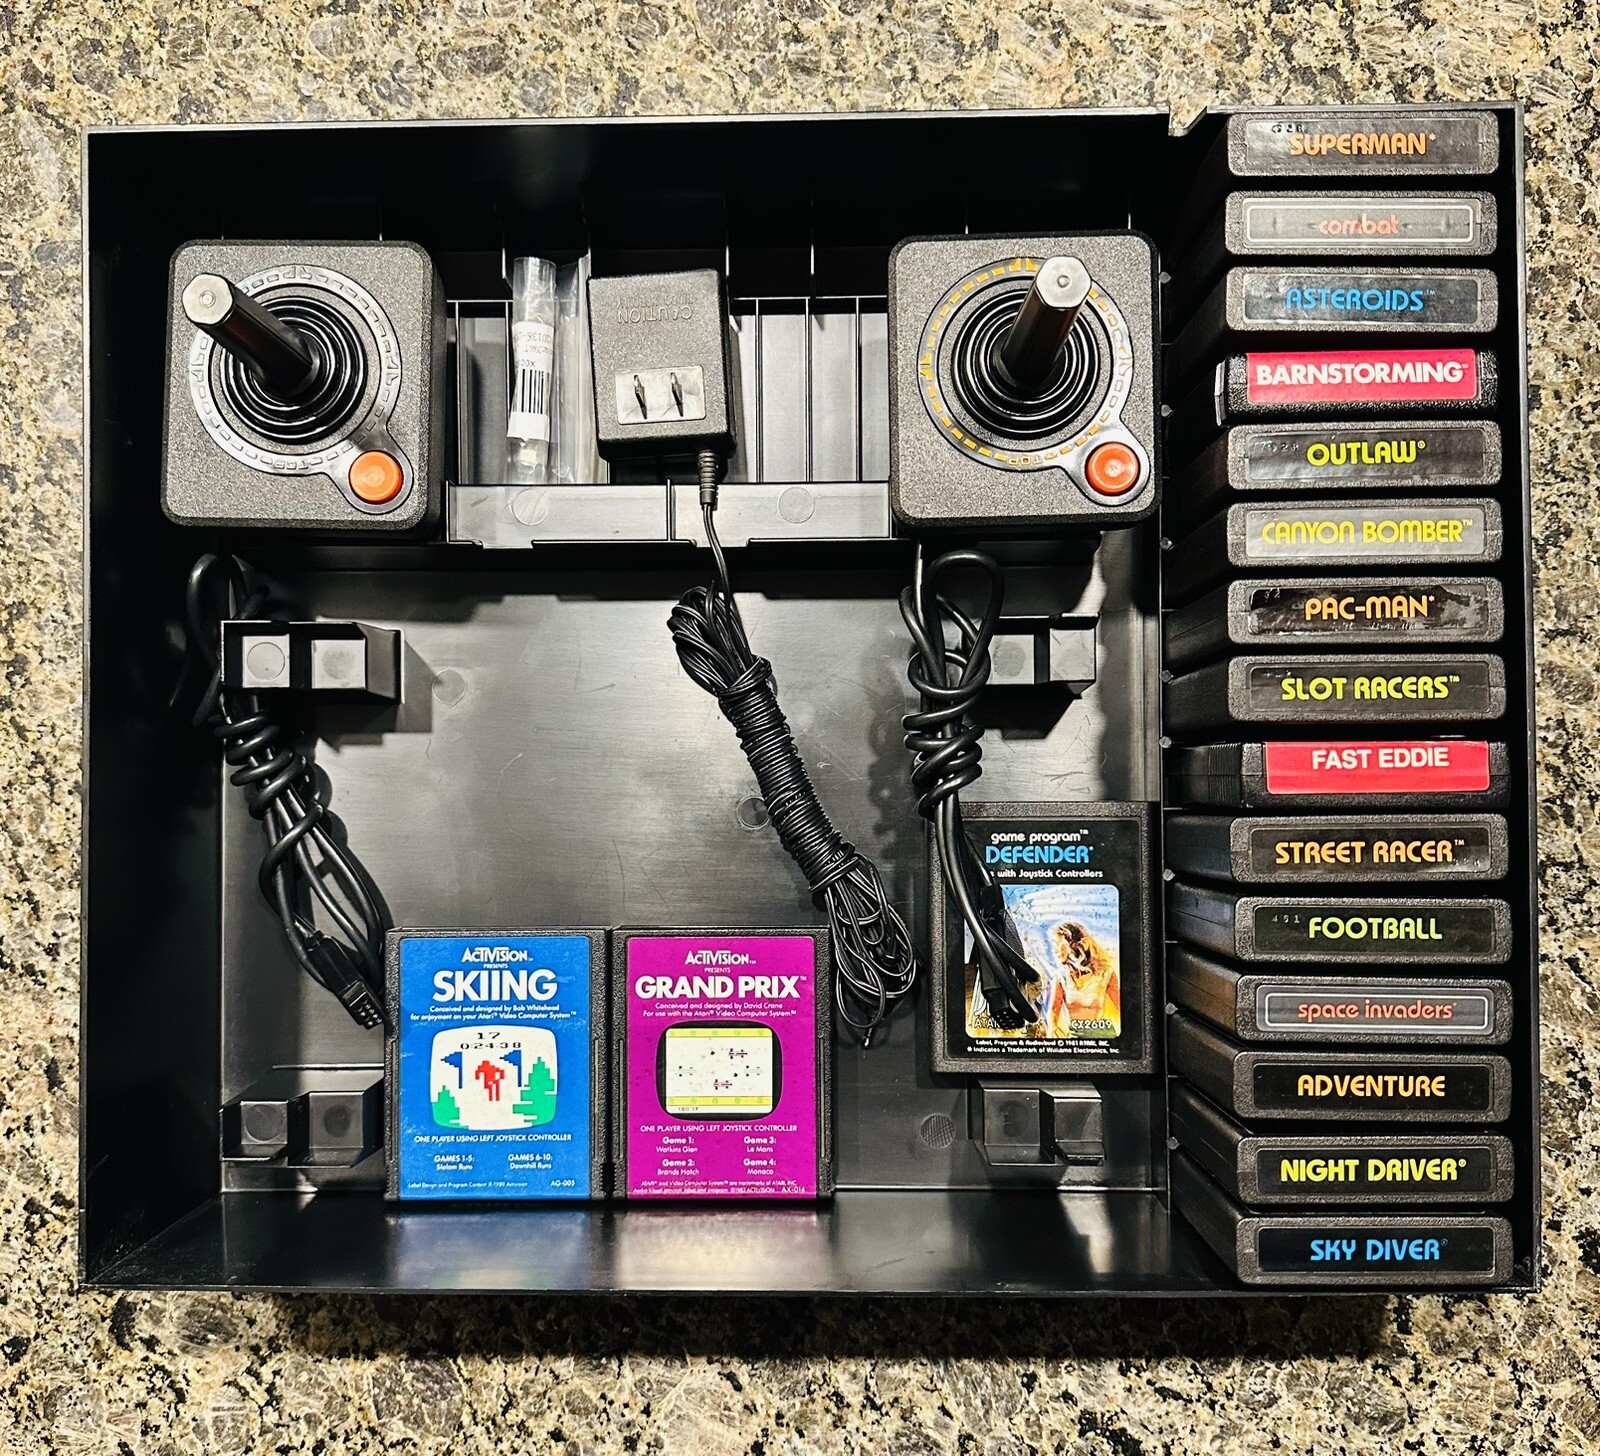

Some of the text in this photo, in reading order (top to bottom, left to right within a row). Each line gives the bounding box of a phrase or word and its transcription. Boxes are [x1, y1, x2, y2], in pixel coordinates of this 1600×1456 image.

[1290, 133, 1426, 156] SUPERMAN
[1318, 214, 1399, 235] combat
[618, 306, 693, 324] CAUTION
[1262, 521, 1355, 545] CANYON
[1304, 595, 1429, 621] PAC-MAN
[1281, 677, 1347, 701] SLOT
[1312, 748, 1450, 769] FAST EDDIE
[991, 833, 1025, 845] game
[986, 845, 1090, 864] DEFENDER
[1275, 841, 1366, 864] STREET
[998, 870, 1016, 878] with
[1018, 869, 1053, 881] Joystick
[1056, 869, 1103, 878] Controllers
[1309, 917, 1442, 940] FOOTBALL
[433, 969, 558, 1002] SKIING
[635, 976, 733, 998] GRAND
[476, 1005, 502, 1013] designed
[503, 1005, 513, 1013] by
[703, 1002, 732, 1011] designed
[734, 1002, 742, 1011] by
[736, 1010, 768, 1018] Computer
[1298, 999, 1453, 1022] space invaders
[421, 1013, 453, 1022] enjoyment
[518, 1012, 549, 1021] Computer
[1071, 1020, 1112, 1029] CX2609
[1297, 1075, 1446, 1097] ADVENTURE
[456, 1134, 479, 1142] USING
[480, 1134, 495, 1142] LEFT
[496, 1134, 527, 1142] JOYSTICK
[508, 1153, 534, 1162] GAMES
[510, 1162, 552, 1170] Downhill Runs
[663, 1159, 695, 1167] Game 2:
[744, 1159, 776, 1167] Game 4:
[658, 1168, 679, 1176] Brands
[1280, 1159, 1359, 1182] NIGHT
[1310, 1239, 1356, 1261] SKY
